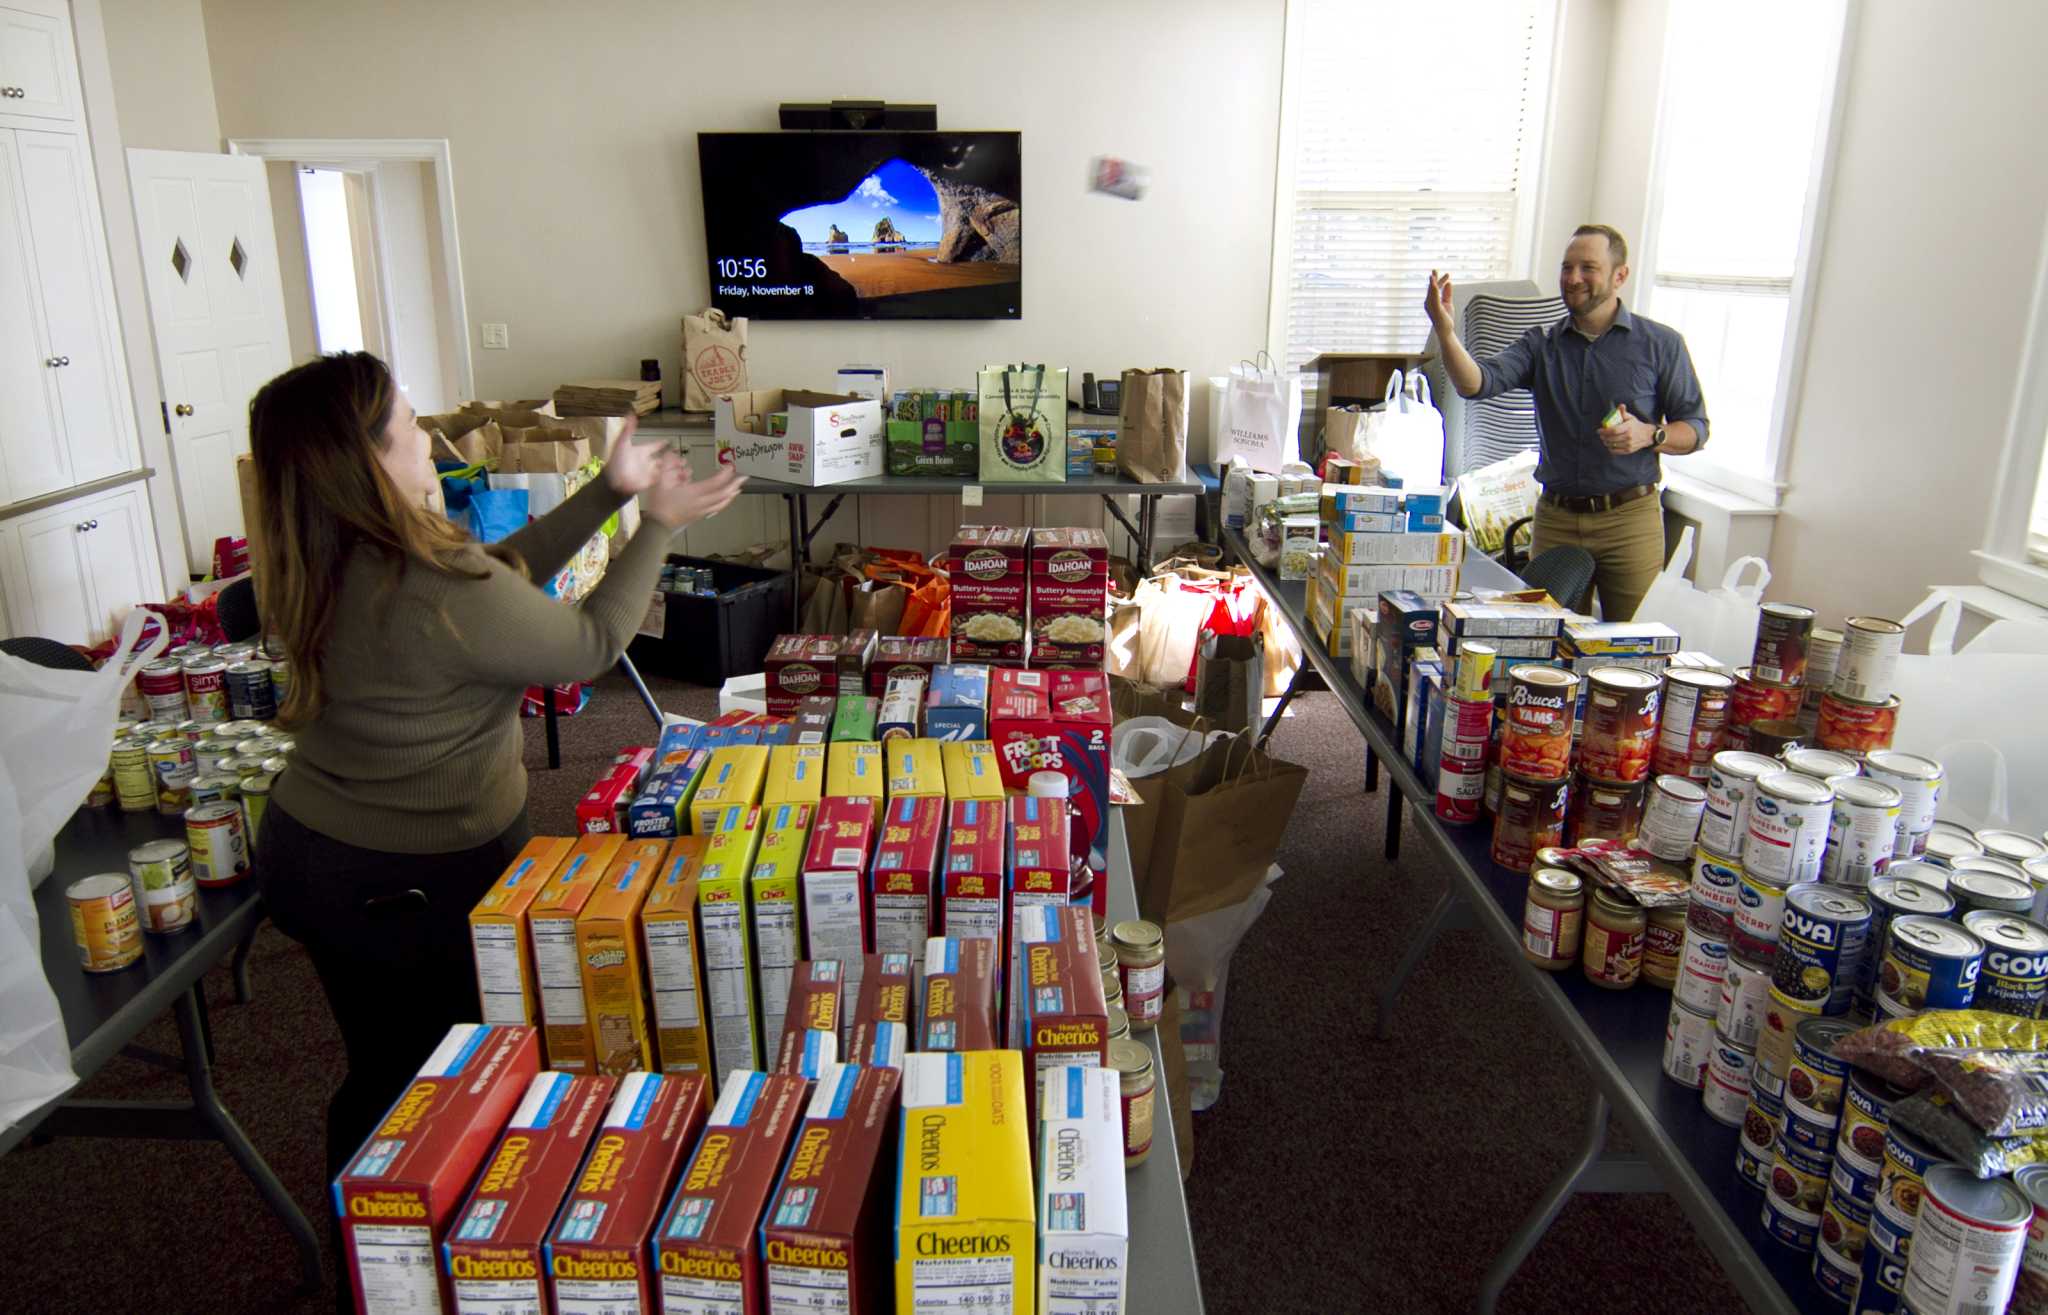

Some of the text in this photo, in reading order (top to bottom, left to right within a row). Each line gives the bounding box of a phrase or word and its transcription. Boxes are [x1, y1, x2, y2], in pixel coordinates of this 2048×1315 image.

[717, 258, 767, 279] 10:56
[719, 284, 814, 297] Friday, November 18
[1231, 428, 1270, 441] WILLIAMS
[735, 439, 784, 462] SnapDragon
[964, 559, 1008, 571] IDAHOAN
[1048, 560, 1092, 573] IDAHOAN
[953, 584, 1020, 593] Buttery Homestyle
[1036, 586, 1104, 595] Buttery Homestyle
[779, 673, 820, 685] IDAHOAN
[1509, 685, 1565, 708] Bruce's
[1519, 708, 1554, 724] YAMS
[1091, 729, 1104, 744] 2
[1003, 736, 1061, 761] FROOT
[1010, 752, 1063, 774] LOOPS
[634, 816, 670, 828] FROSTED
[637, 823, 667, 834] FLAKES
[1784, 908, 1832, 943] OYA
[1037, 1029, 1099, 1046] Cheerios
[378, 1082, 437, 1136] Cheerios
[1849, 1088, 1872, 1112] OYA
[921, 1114, 946, 1171] Cheerios
[479, 1136, 530, 1193] Cheerios
[577, 1135, 626, 1193] Cheerios
[685, 1134, 731, 1190] Cheerios
[788, 1128, 831, 1180] Cheerios
[1057, 1128, 1080, 1182] Cheerios
[351, 1196, 426, 1218] Cheerios
[767, 1241, 848, 1267] Cheerios
[917, 1232, 1010, 1255] Cheerios
[452, 1255, 536, 1277] Cheerios
[553, 1256, 637, 1278] Cheerios
[660, 1252, 741, 1279] Cheerios
[916, 1257, 972, 1266] Nutrition
[1049, 1252, 1118, 1271] Cheerios
